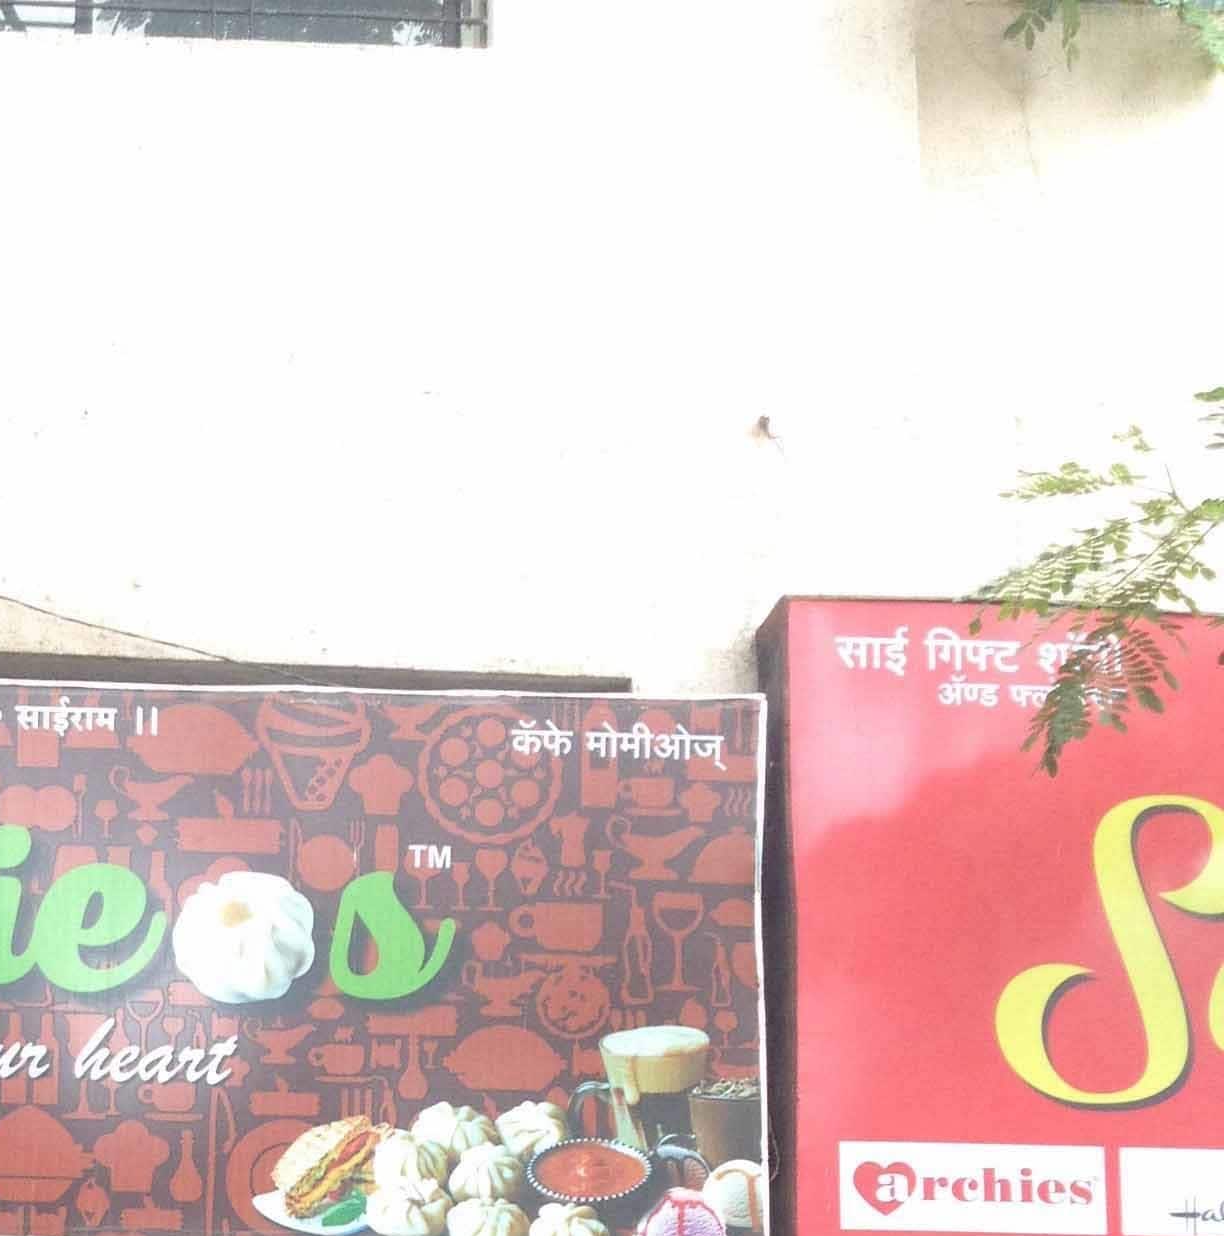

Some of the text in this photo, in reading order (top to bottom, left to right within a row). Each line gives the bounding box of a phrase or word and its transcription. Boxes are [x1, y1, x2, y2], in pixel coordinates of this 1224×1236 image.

[834, 626, 910, 675] साई
[924, 627, 1021, 673] गिफ्ट
[14, 695, 118, 737] साईराम
[72, 1017, 241, 1085] heart
[875, 1166, 1095, 1206] archies
